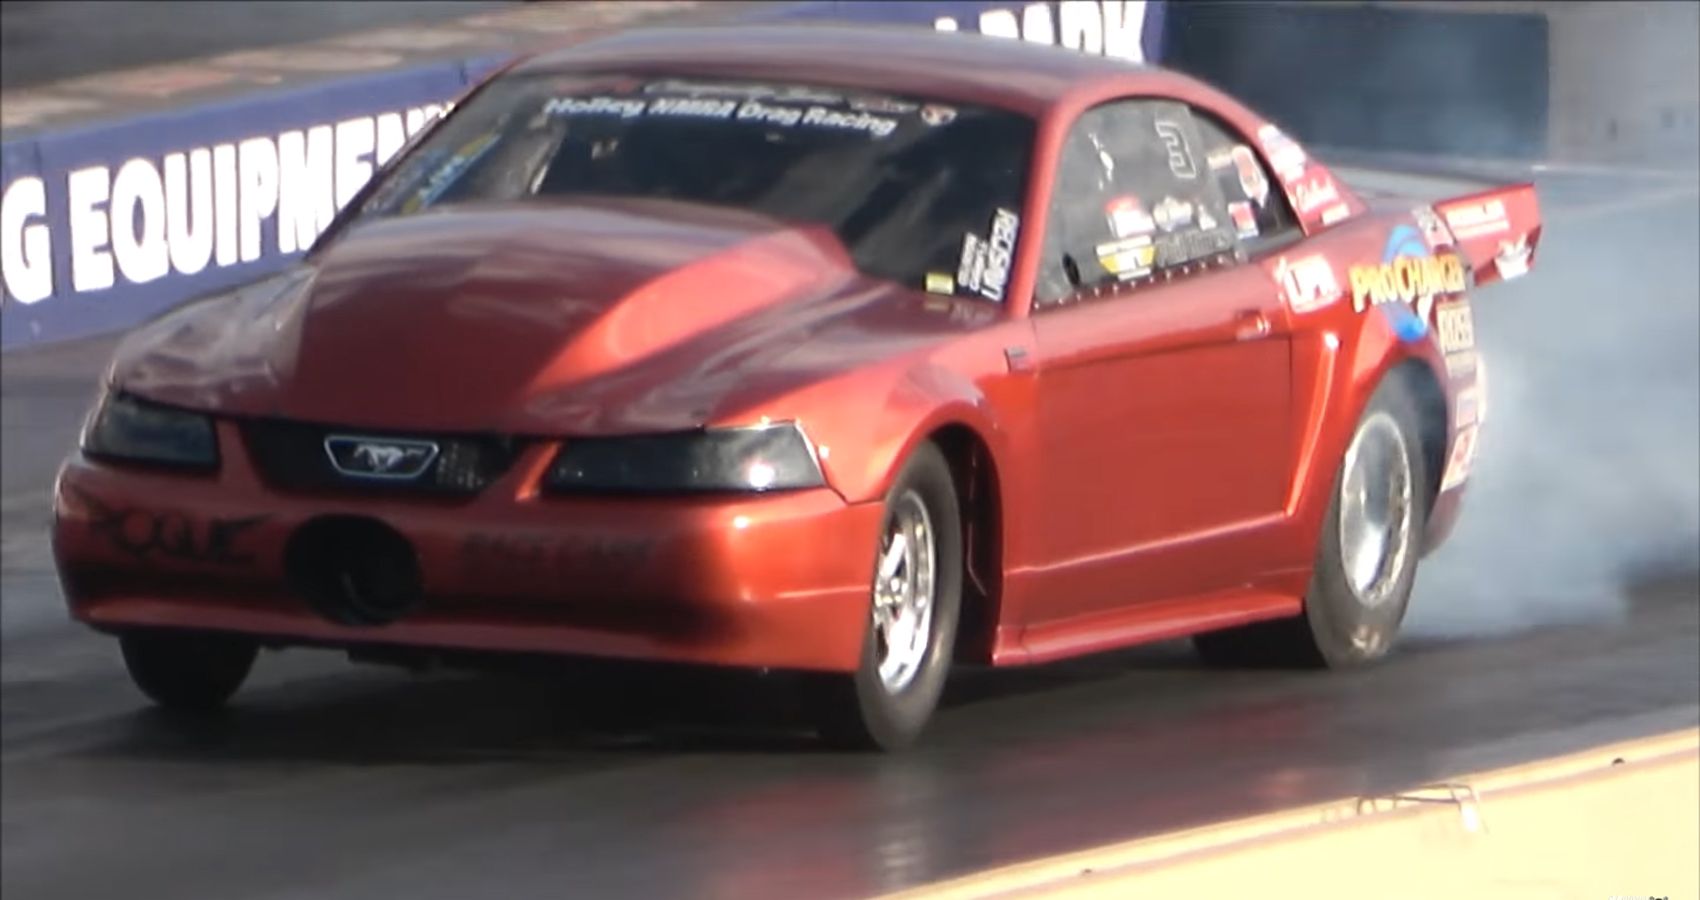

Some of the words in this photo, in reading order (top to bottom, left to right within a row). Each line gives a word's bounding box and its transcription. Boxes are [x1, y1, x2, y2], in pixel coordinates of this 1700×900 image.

[648, 97, 737, 119] NMRA
[736, 101, 801, 126] Drag
[802, 106, 898, 137] Racing
[1154, 120, 1197, 179] 3
[1, 176, 54, 305] G
